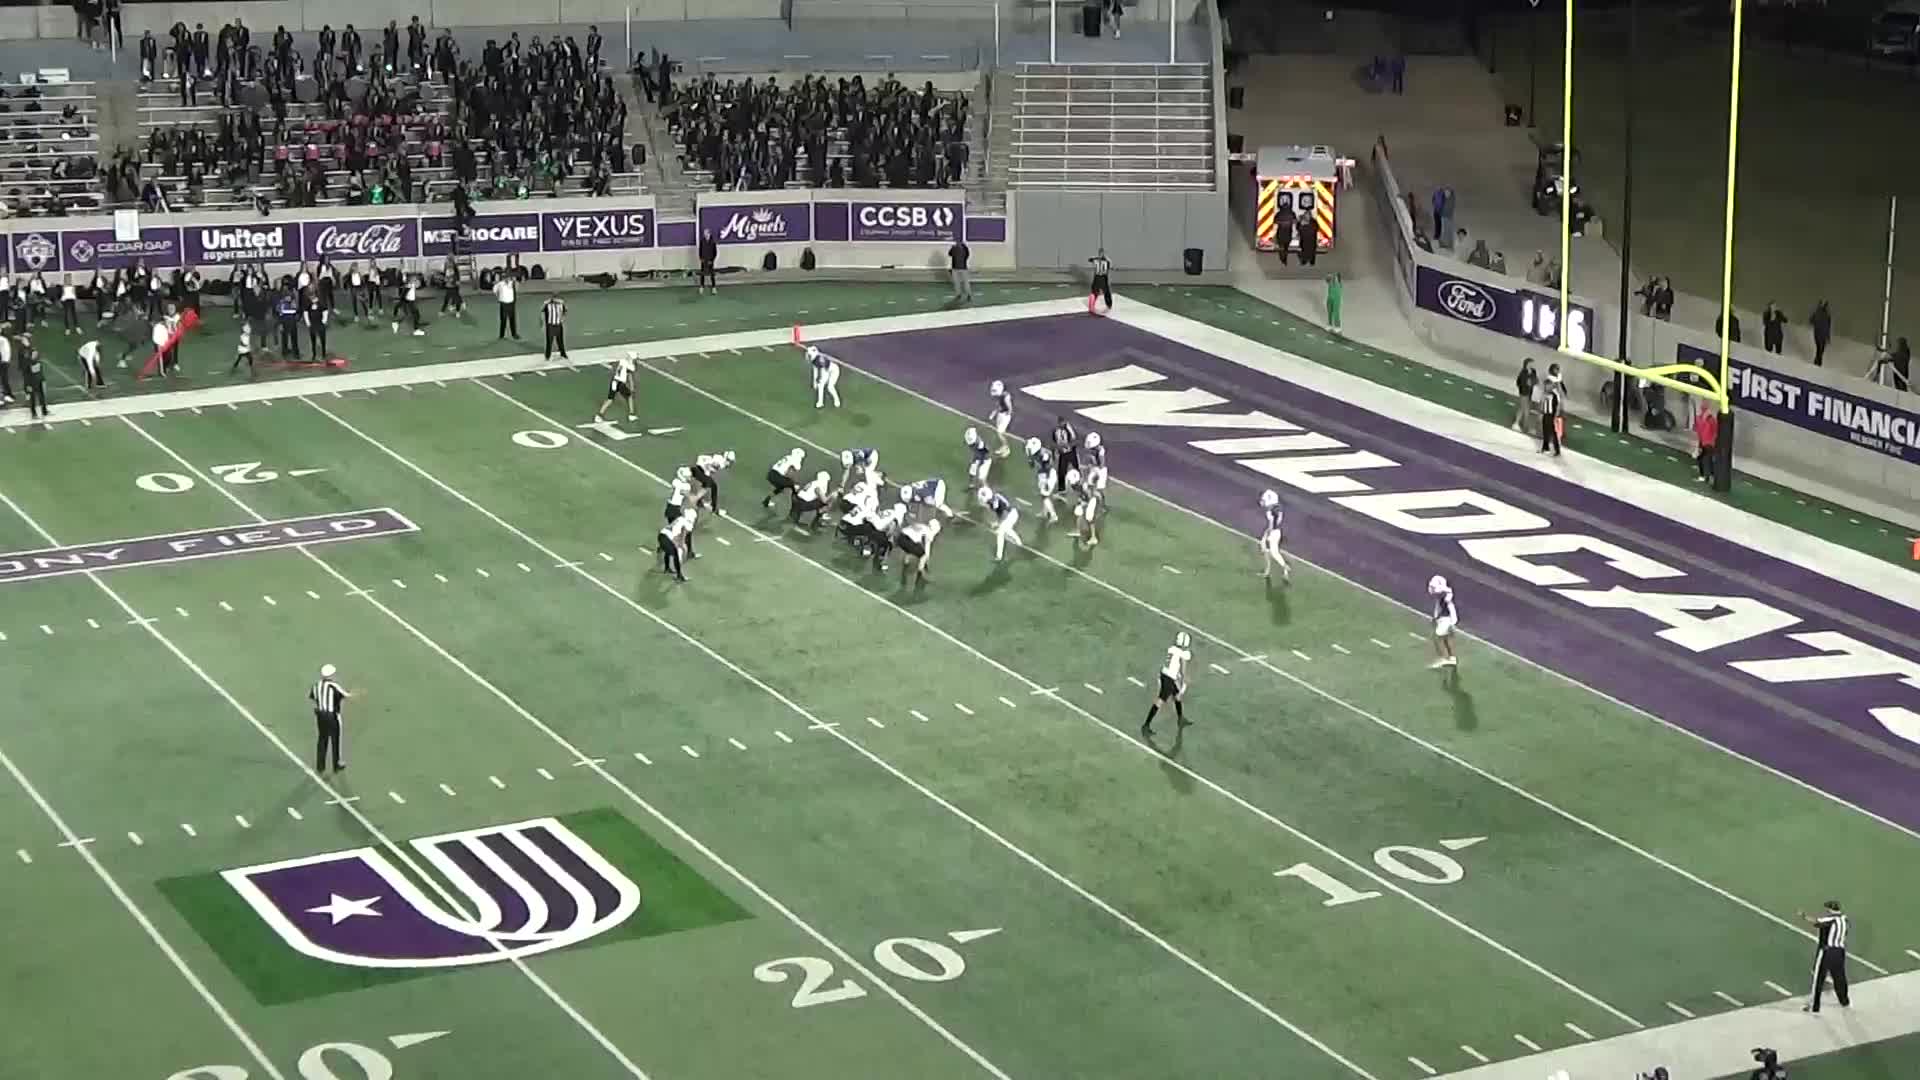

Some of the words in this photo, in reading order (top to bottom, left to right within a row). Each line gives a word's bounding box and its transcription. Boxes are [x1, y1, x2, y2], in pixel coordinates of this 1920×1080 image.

[553, 214, 645, 238] VEXUS
[860, 206, 928, 227] CCSB
[202, 226, 283, 249] United
[316, 223, 405, 254] Coca-Cola
[424, 226, 538, 244] MEOCARE
[203, 246, 284, 261] supermarkets
[1447, 285, 1486, 318] Ford
[1728, 366, 1801, 410] FIRST
[168, 517, 377, 552] FIELD
